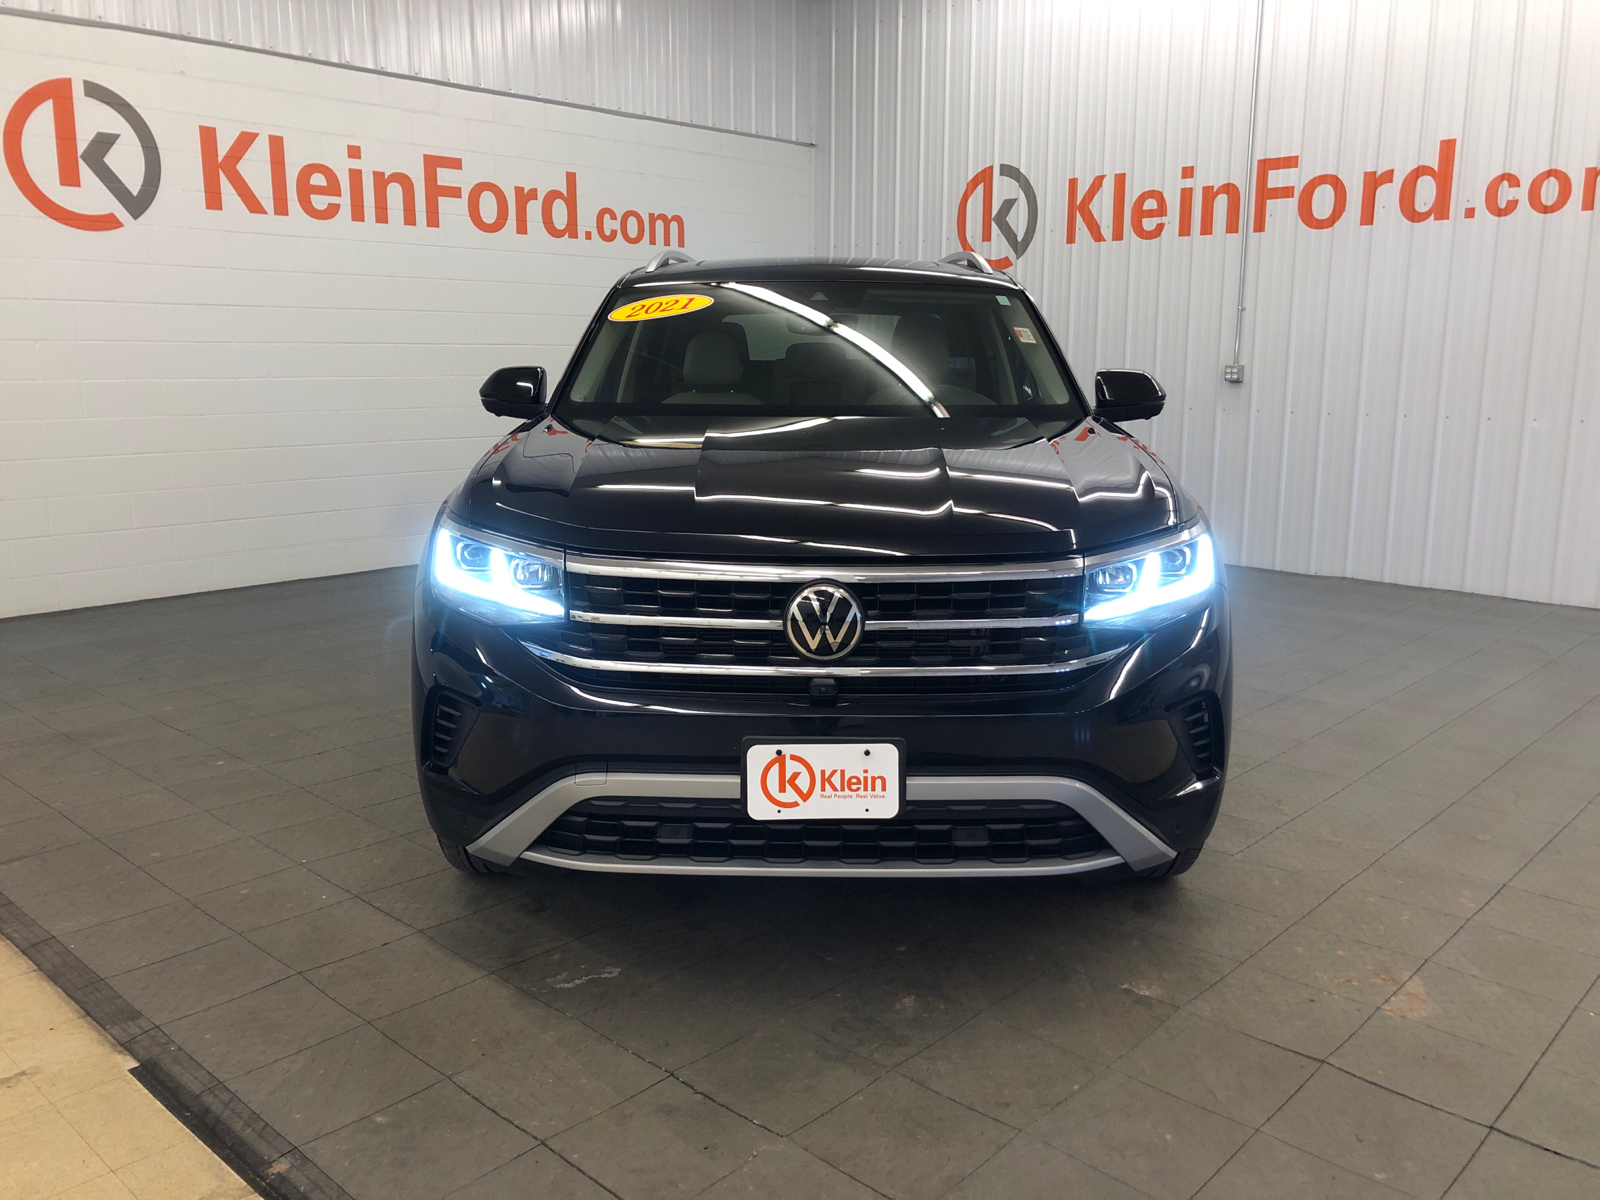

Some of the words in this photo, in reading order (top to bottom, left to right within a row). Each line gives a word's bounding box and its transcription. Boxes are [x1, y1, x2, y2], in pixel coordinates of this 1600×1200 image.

[197, 124, 685, 249] KleinFord.com
[625, 297, 696, 319] 2021
[820, 769, 887, 793] Klein
